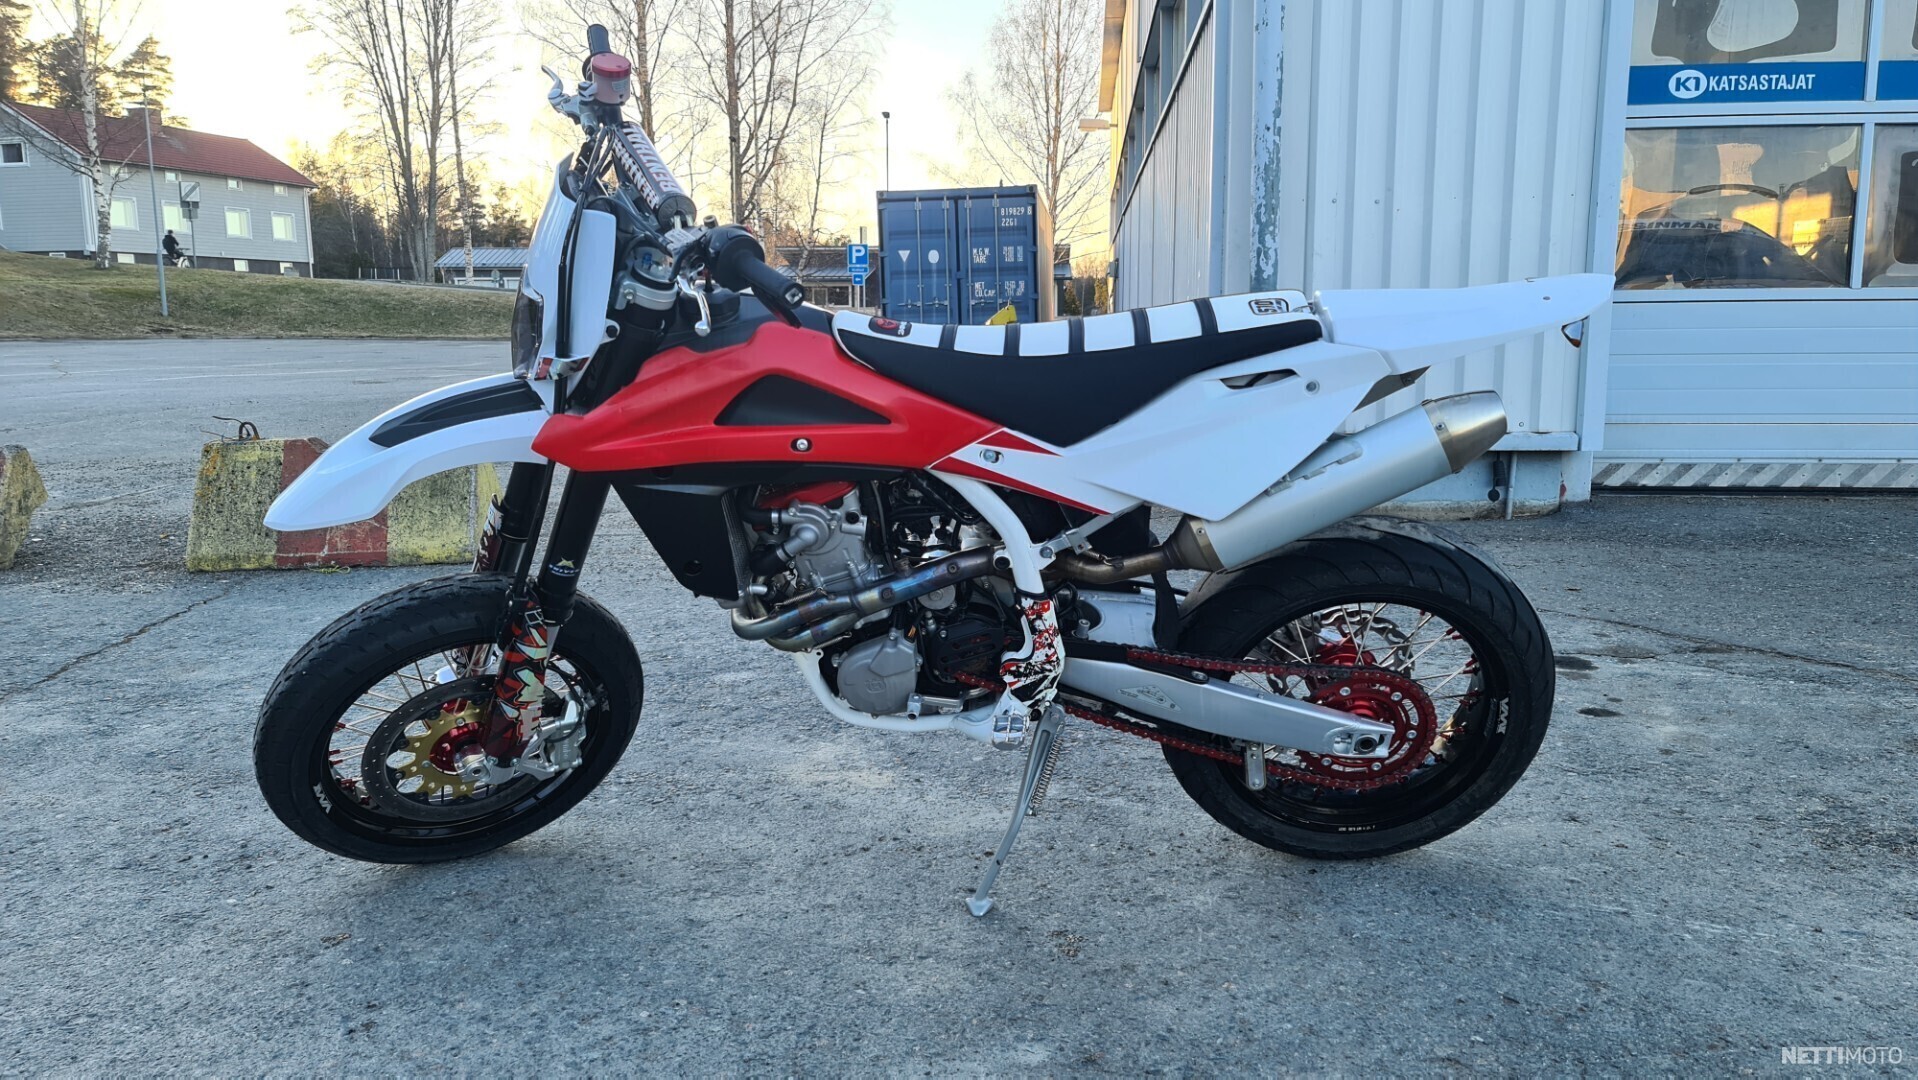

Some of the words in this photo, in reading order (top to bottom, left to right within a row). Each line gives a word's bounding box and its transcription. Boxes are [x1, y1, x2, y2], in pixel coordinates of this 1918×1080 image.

[1708, 74, 1816, 92] KATSASTAJAT
[622, 124, 686, 195] RENTHAL
[1001, 218, 1018, 227] 22G1
[852, 246, 866, 264] P
[973, 255, 987, 264] TARE
[974, 281, 985, 290] NET
